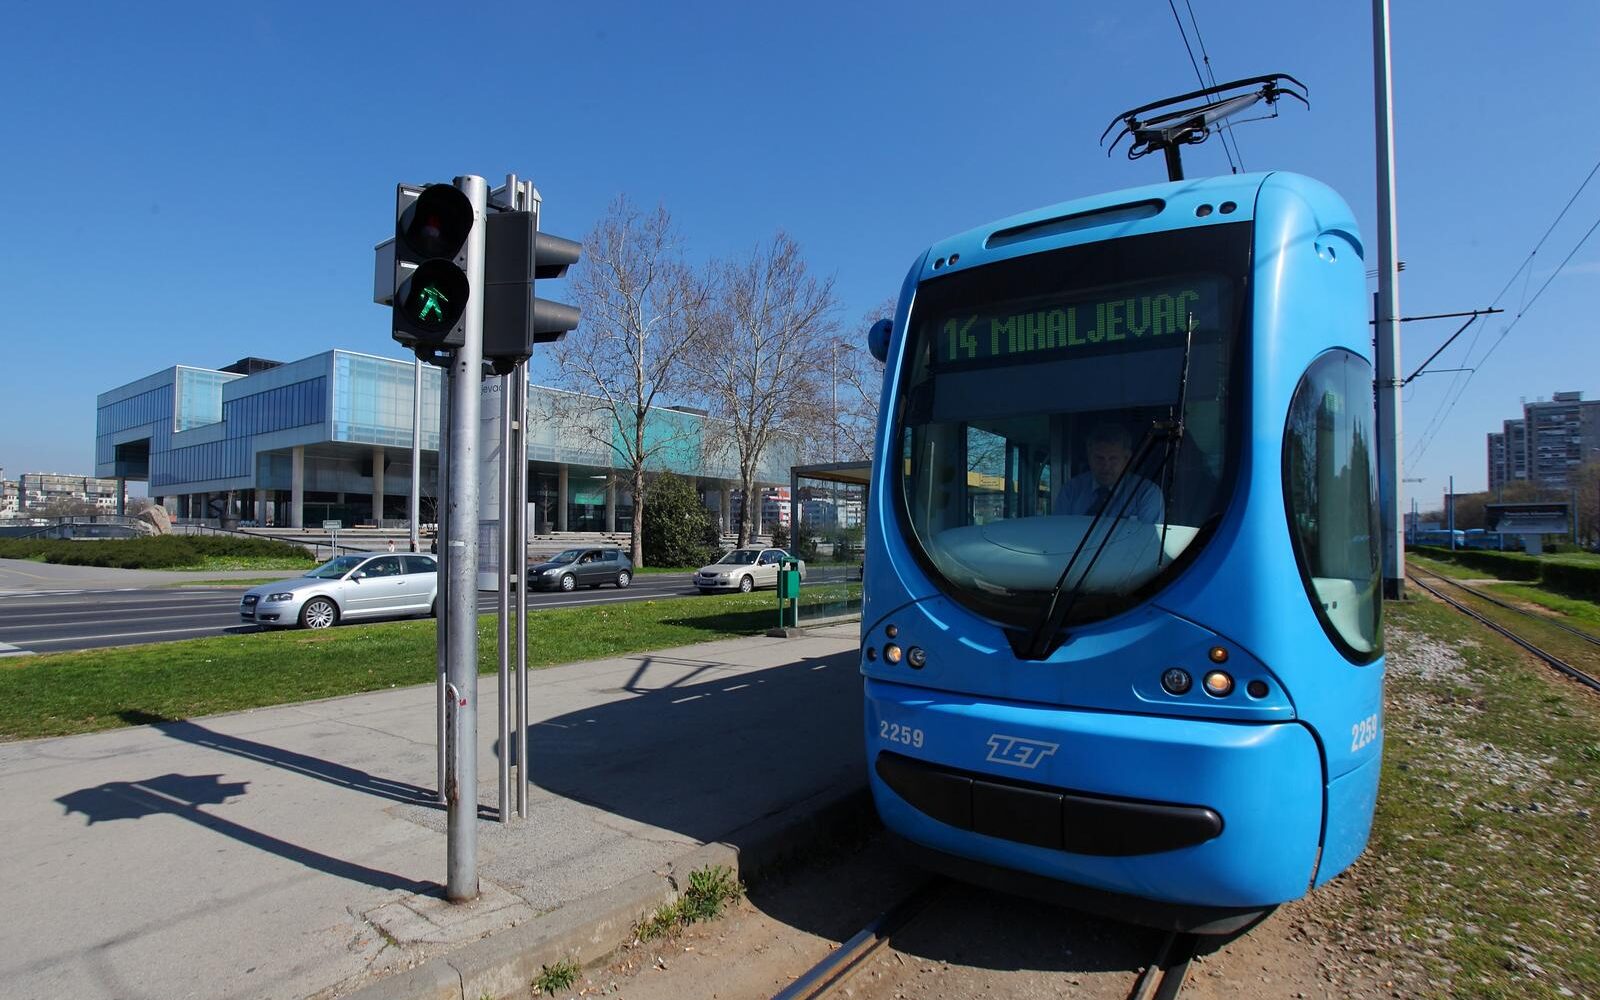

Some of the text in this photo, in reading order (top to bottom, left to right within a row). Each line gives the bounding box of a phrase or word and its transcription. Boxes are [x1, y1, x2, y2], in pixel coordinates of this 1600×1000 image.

[944, 291, 1200, 360] 14 MIHALJEVAC
[879, 720, 924, 748] 2259
[986, 734, 1060, 768] ZET
[1352, 714, 1377, 752] 2259
